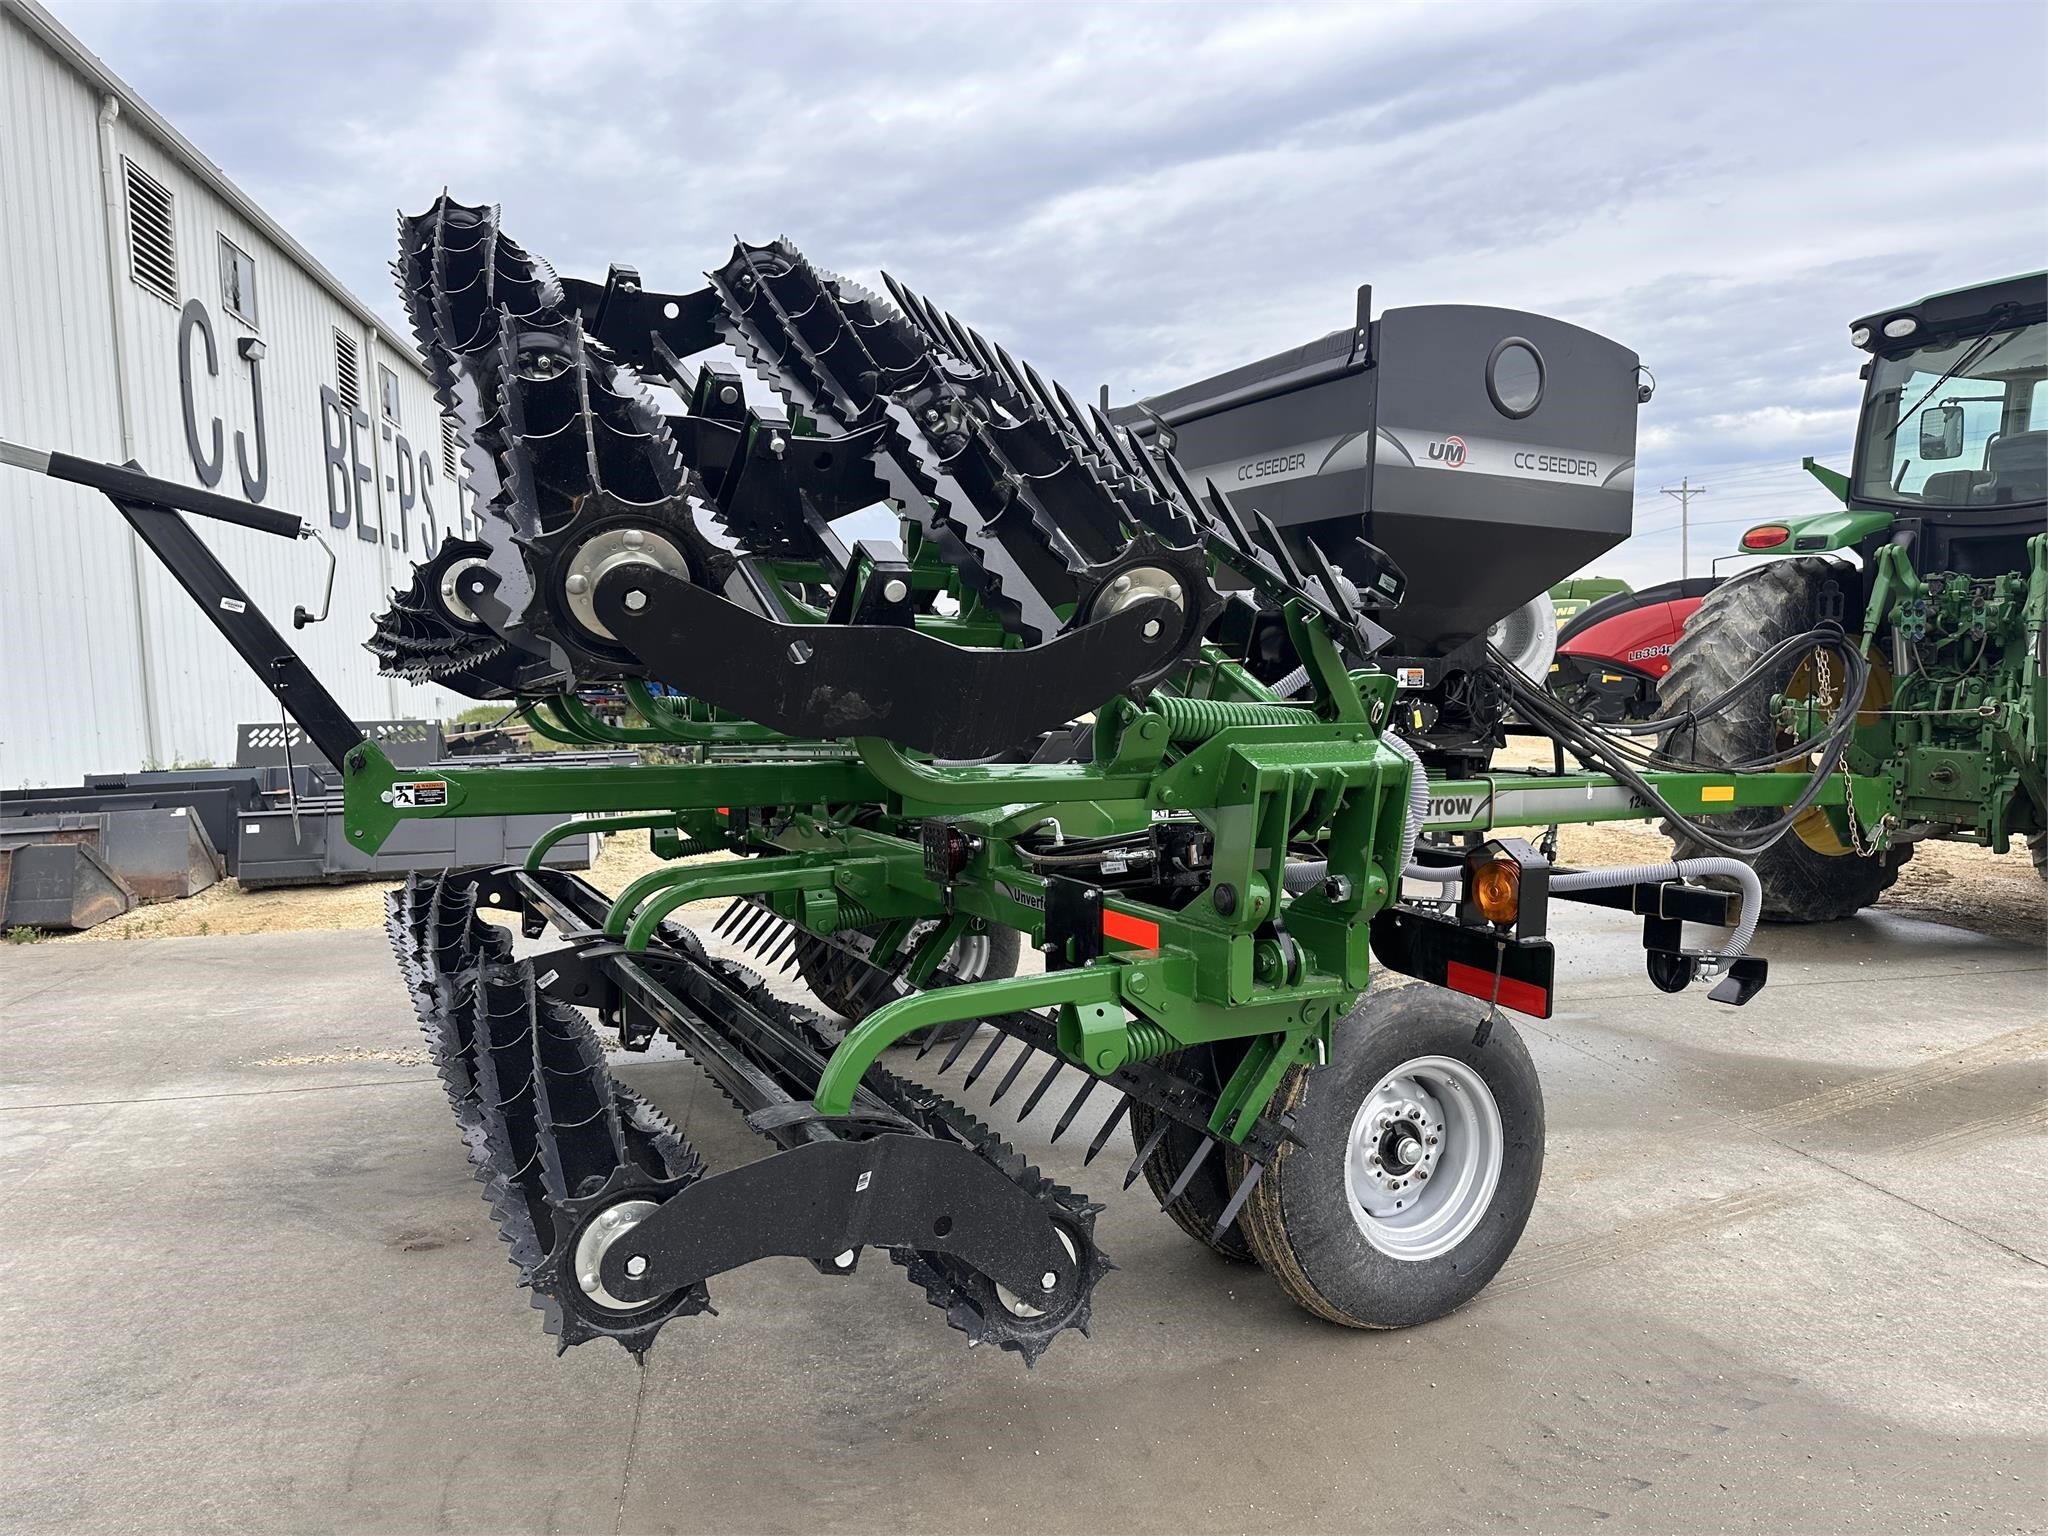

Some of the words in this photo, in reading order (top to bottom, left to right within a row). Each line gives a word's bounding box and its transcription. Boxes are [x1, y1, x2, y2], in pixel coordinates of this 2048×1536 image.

[179, 299, 268, 503] CJ
[1428, 442, 1463, 462] UM
[1237, 464, 1254, 481] CC
[1255, 453, 1306, 478] SEEDER
[1514, 452, 1535, 470] CC
[1538, 455, 1598, 478] SEEDER
[1426, 798, 1473, 816] rrow
[1630, 795, 1651, 809] 124
[1013, 887, 1047, 910] Unverf
